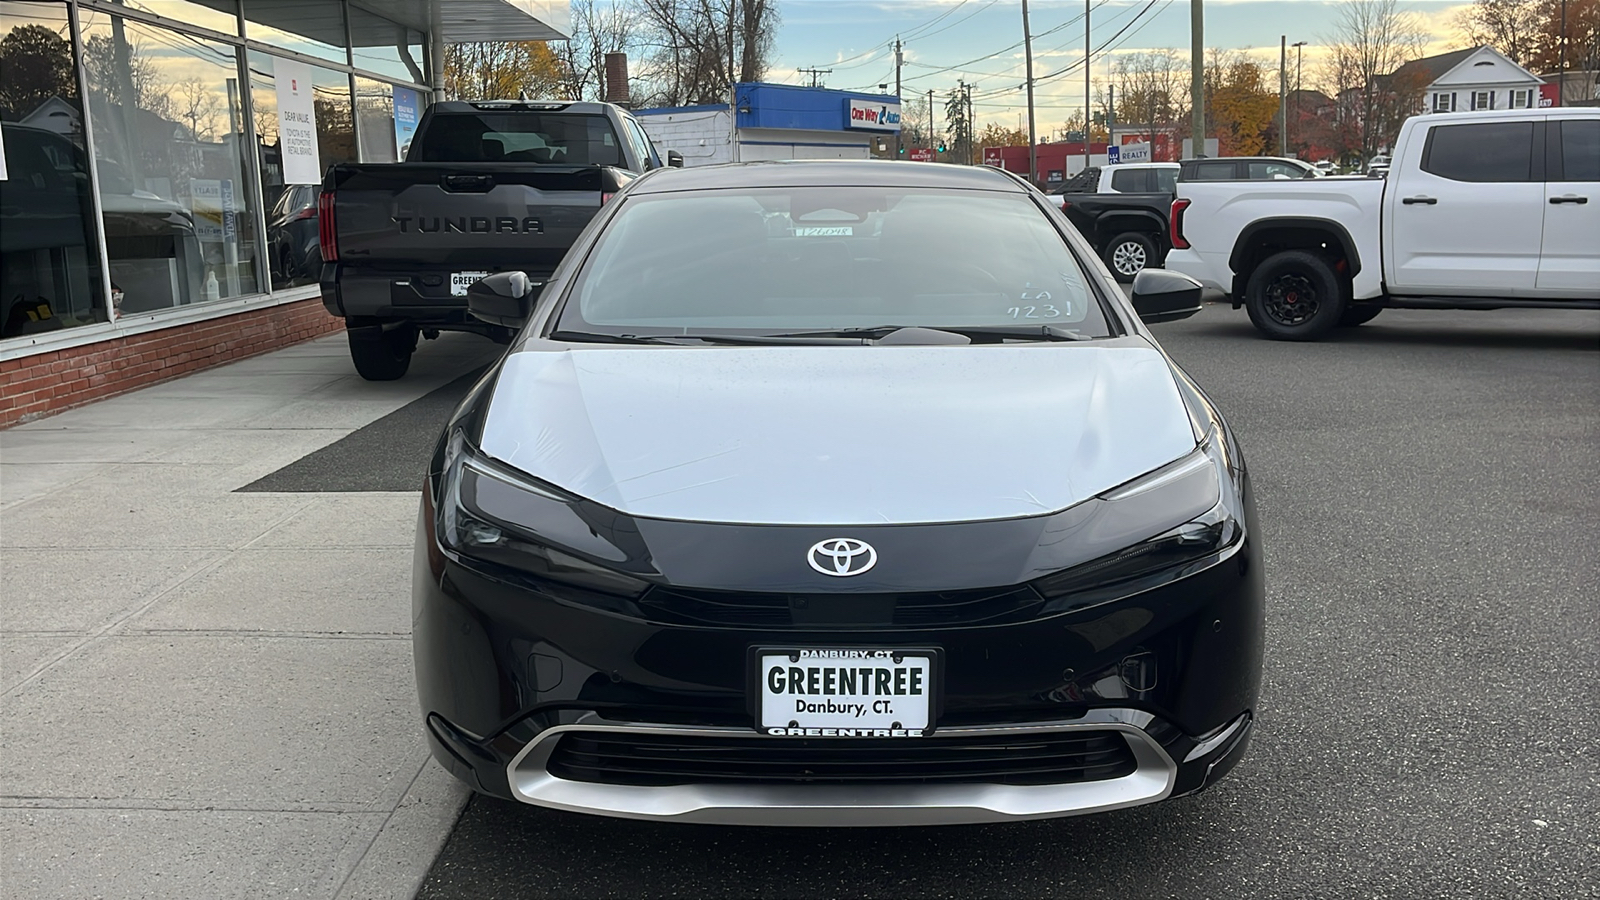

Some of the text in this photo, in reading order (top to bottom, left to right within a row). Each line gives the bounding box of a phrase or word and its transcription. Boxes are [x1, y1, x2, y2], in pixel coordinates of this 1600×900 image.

[284, 111, 296, 121] DEAR
[852, 107, 900, 124] One Way Auto
[1122, 150, 1148, 160] REALTY
[392, 217, 544, 234] TUNDRA
[800, 650, 893, 659] DANBURY, CT
[768, 666, 922, 695] GREENTREE
[796, 699, 893, 718] Danbury, CT.
[767, 728, 923, 738] GREENTREE
